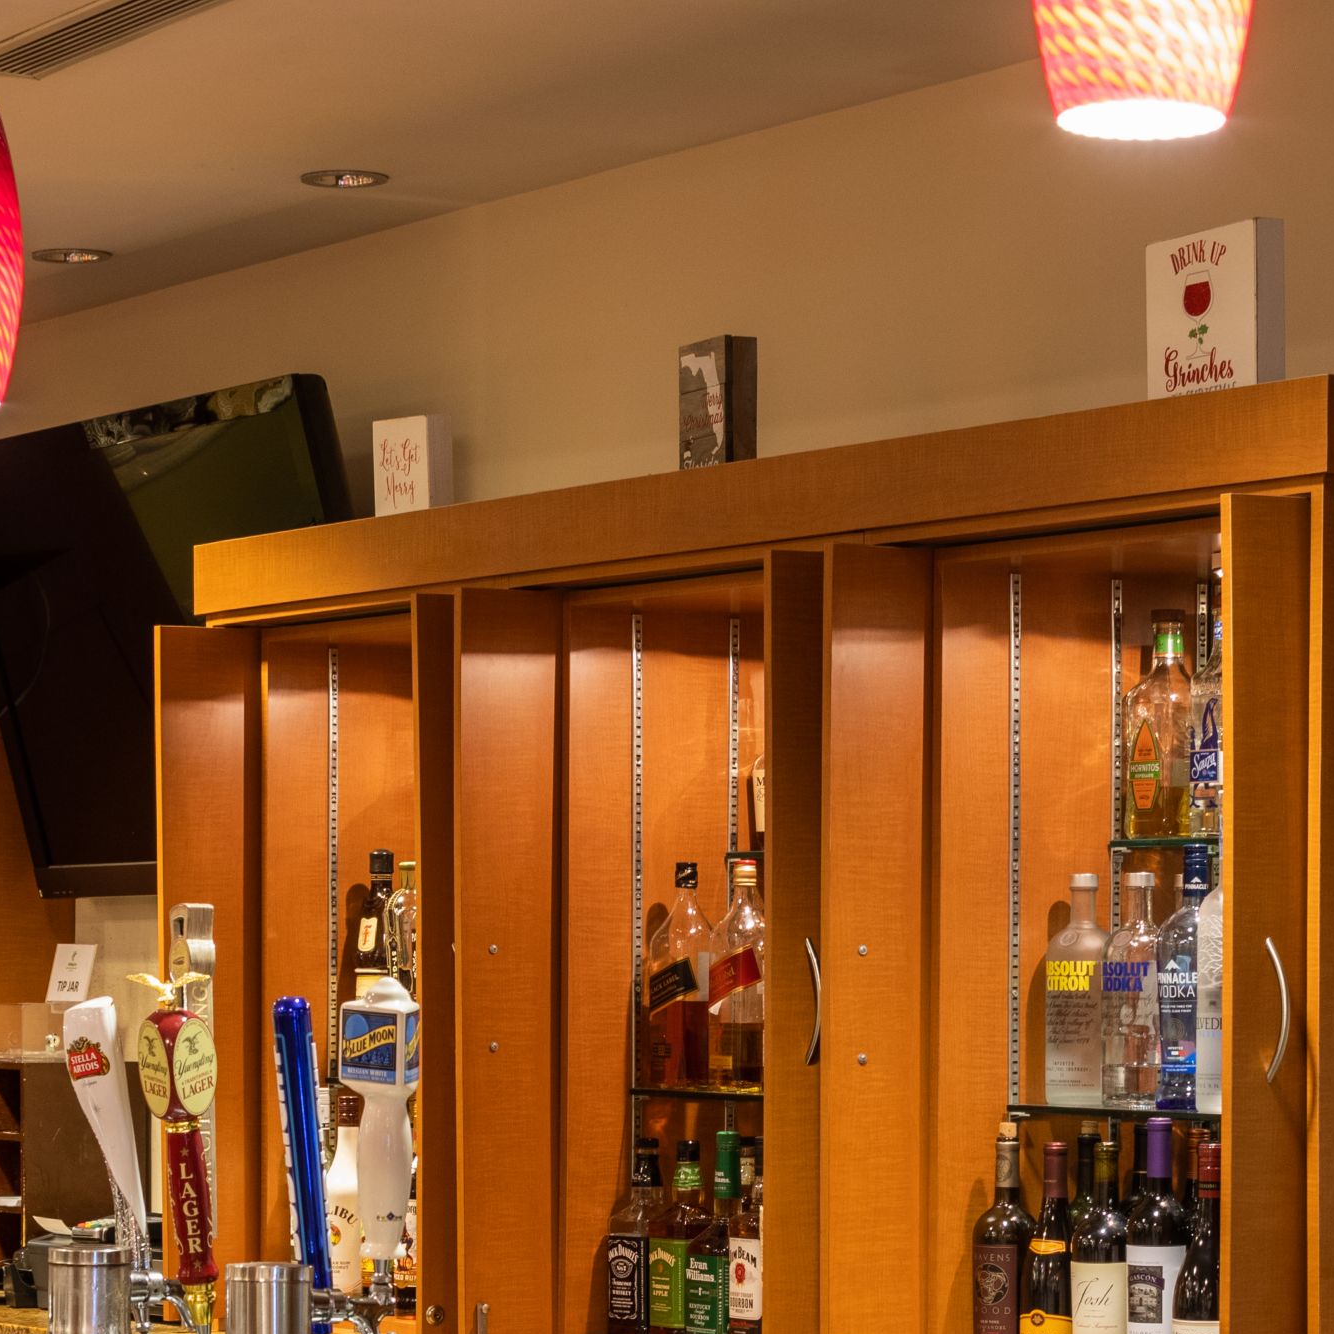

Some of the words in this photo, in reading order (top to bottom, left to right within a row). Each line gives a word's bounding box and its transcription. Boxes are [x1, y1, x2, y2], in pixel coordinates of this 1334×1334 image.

[1170, 240, 1207, 276] DRINK
[1210, 241, 1227, 266] UP
[1164, 346, 1235, 393] Grinches
[401, 438, 419, 477] Get
[385, 472, 416, 509] Merry
[1130, 762, 1160, 773] HORNITOS
[1191, 752, 1218, 779] Sauza
[57, 980, 68, 993] TIP
[67, 980, 80, 993] JAR
[1157, 972, 1198, 985] PINNACLE
[1160, 984, 1196, 999] VODKA
[343, 1038, 367, 1058] BLUE
[368, 1027, 395, 1048] MOON
[70, 1052, 98, 1065] STELLA
[73, 1061, 100, 1074] ARTOIS
[174, 1053, 215, 1080] Yuengling
[144, 1080, 168, 1098] LAGER
[182, 1075, 214, 1100] LAGER
[179, 1162, 204, 1255] LAGER
[331, 1205, 358, 1225] IBU
[617, 1243, 641, 1264] DANIEL'S
[657, 1247, 676, 1268] DANIEL'S
[689, 1257, 709, 1270] Evan
[737, 1245, 758, 1269] BEAM
[978, 1252, 1011, 1262] AVENS
[611, 1289, 632, 1297] WHISKEY
[1074, 1278, 1114, 1320] Josh
[688, 1303, 711, 1311] KENTUCKY
[689, 1313, 710, 1321] BOURBON
